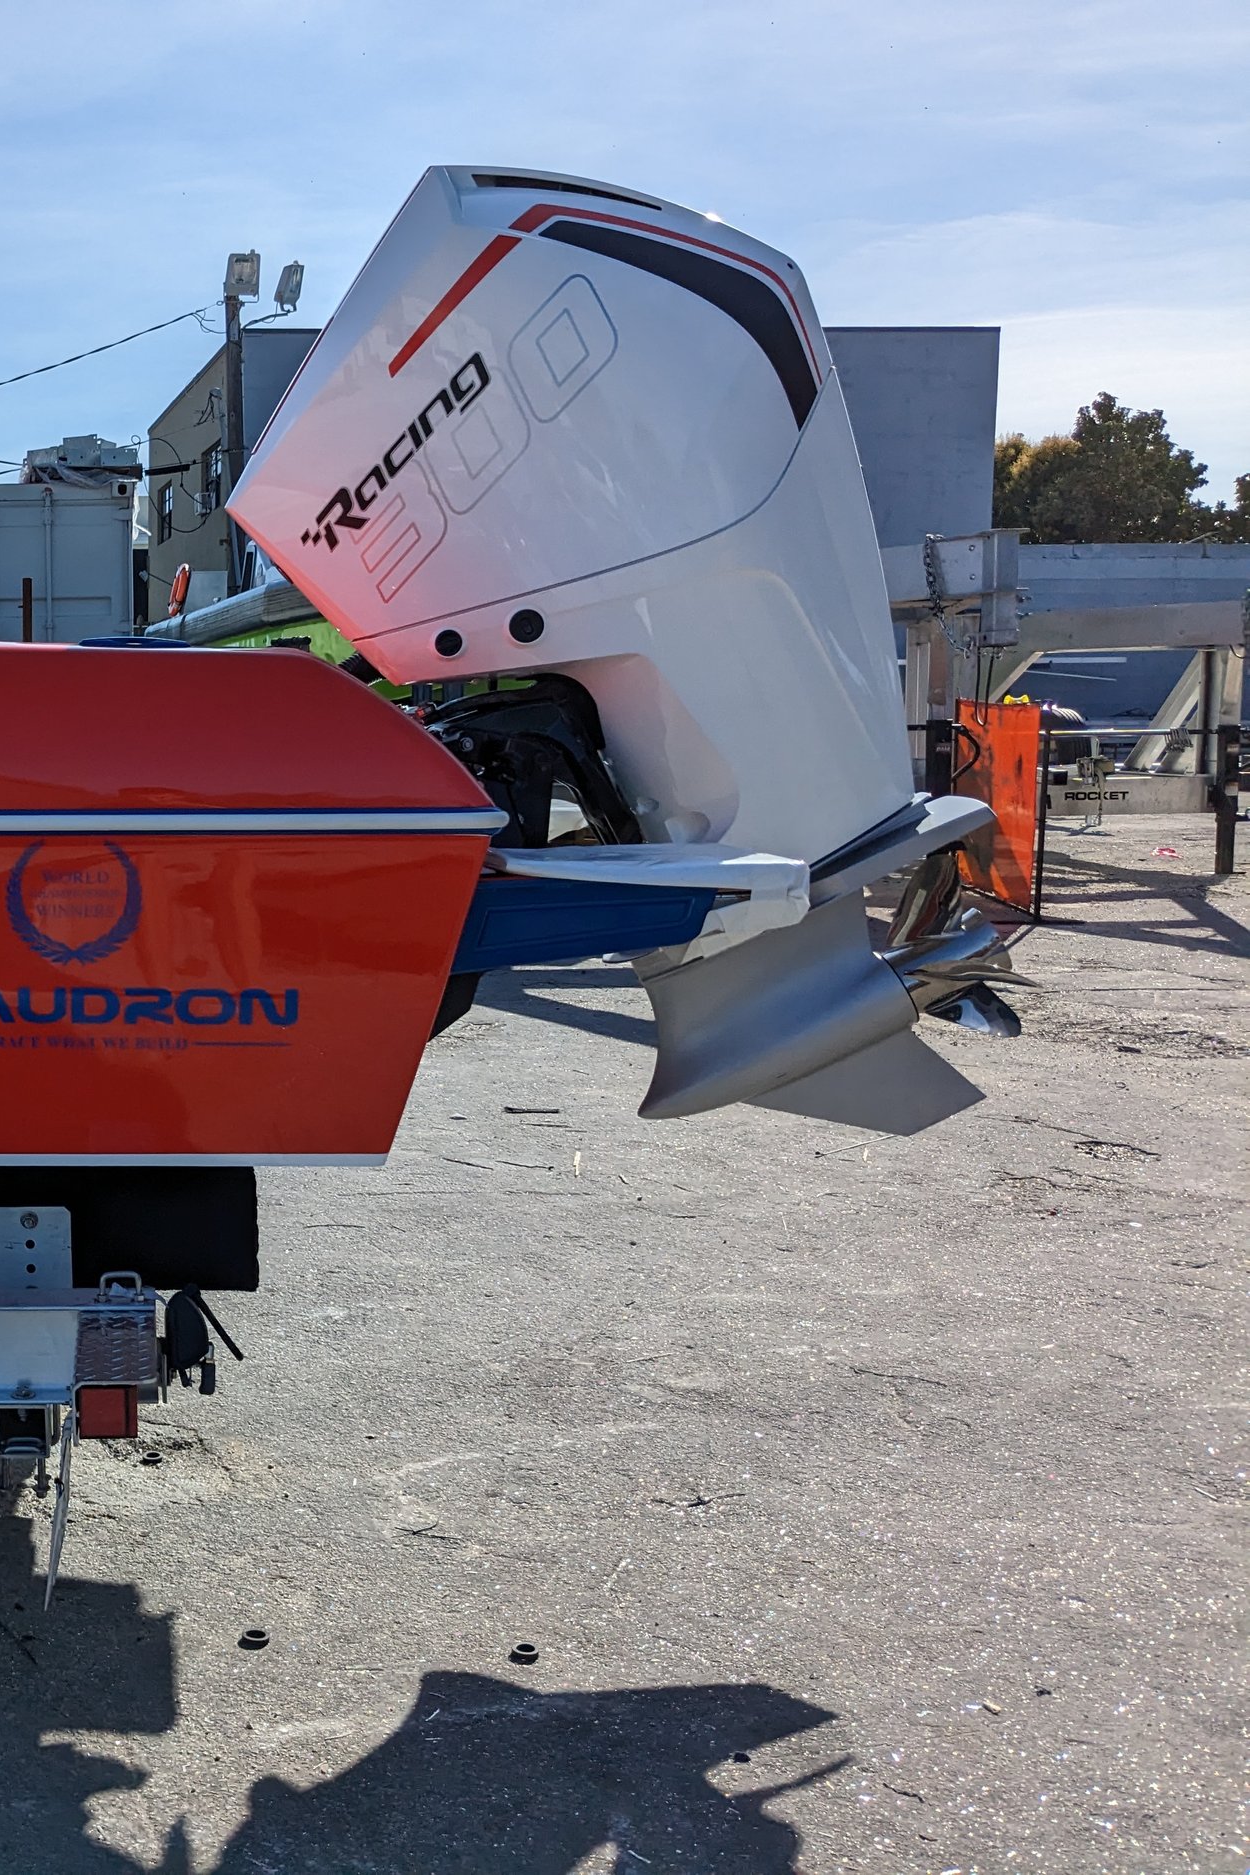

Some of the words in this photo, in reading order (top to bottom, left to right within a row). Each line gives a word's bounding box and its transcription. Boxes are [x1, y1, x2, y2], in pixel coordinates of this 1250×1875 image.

[349, 273, 619, 604] 300
[312, 351, 491, 553] Racing
[1064, 791, 1129, 801] ROCKET
[41, 869, 111, 884] WORLD
[35, 903, 119, 918] WINNERS
[47, 1035, 96, 1049] WHAT
[103, 1036, 129, 1049] WE
[134, 1036, 189, 1050] BUILD
